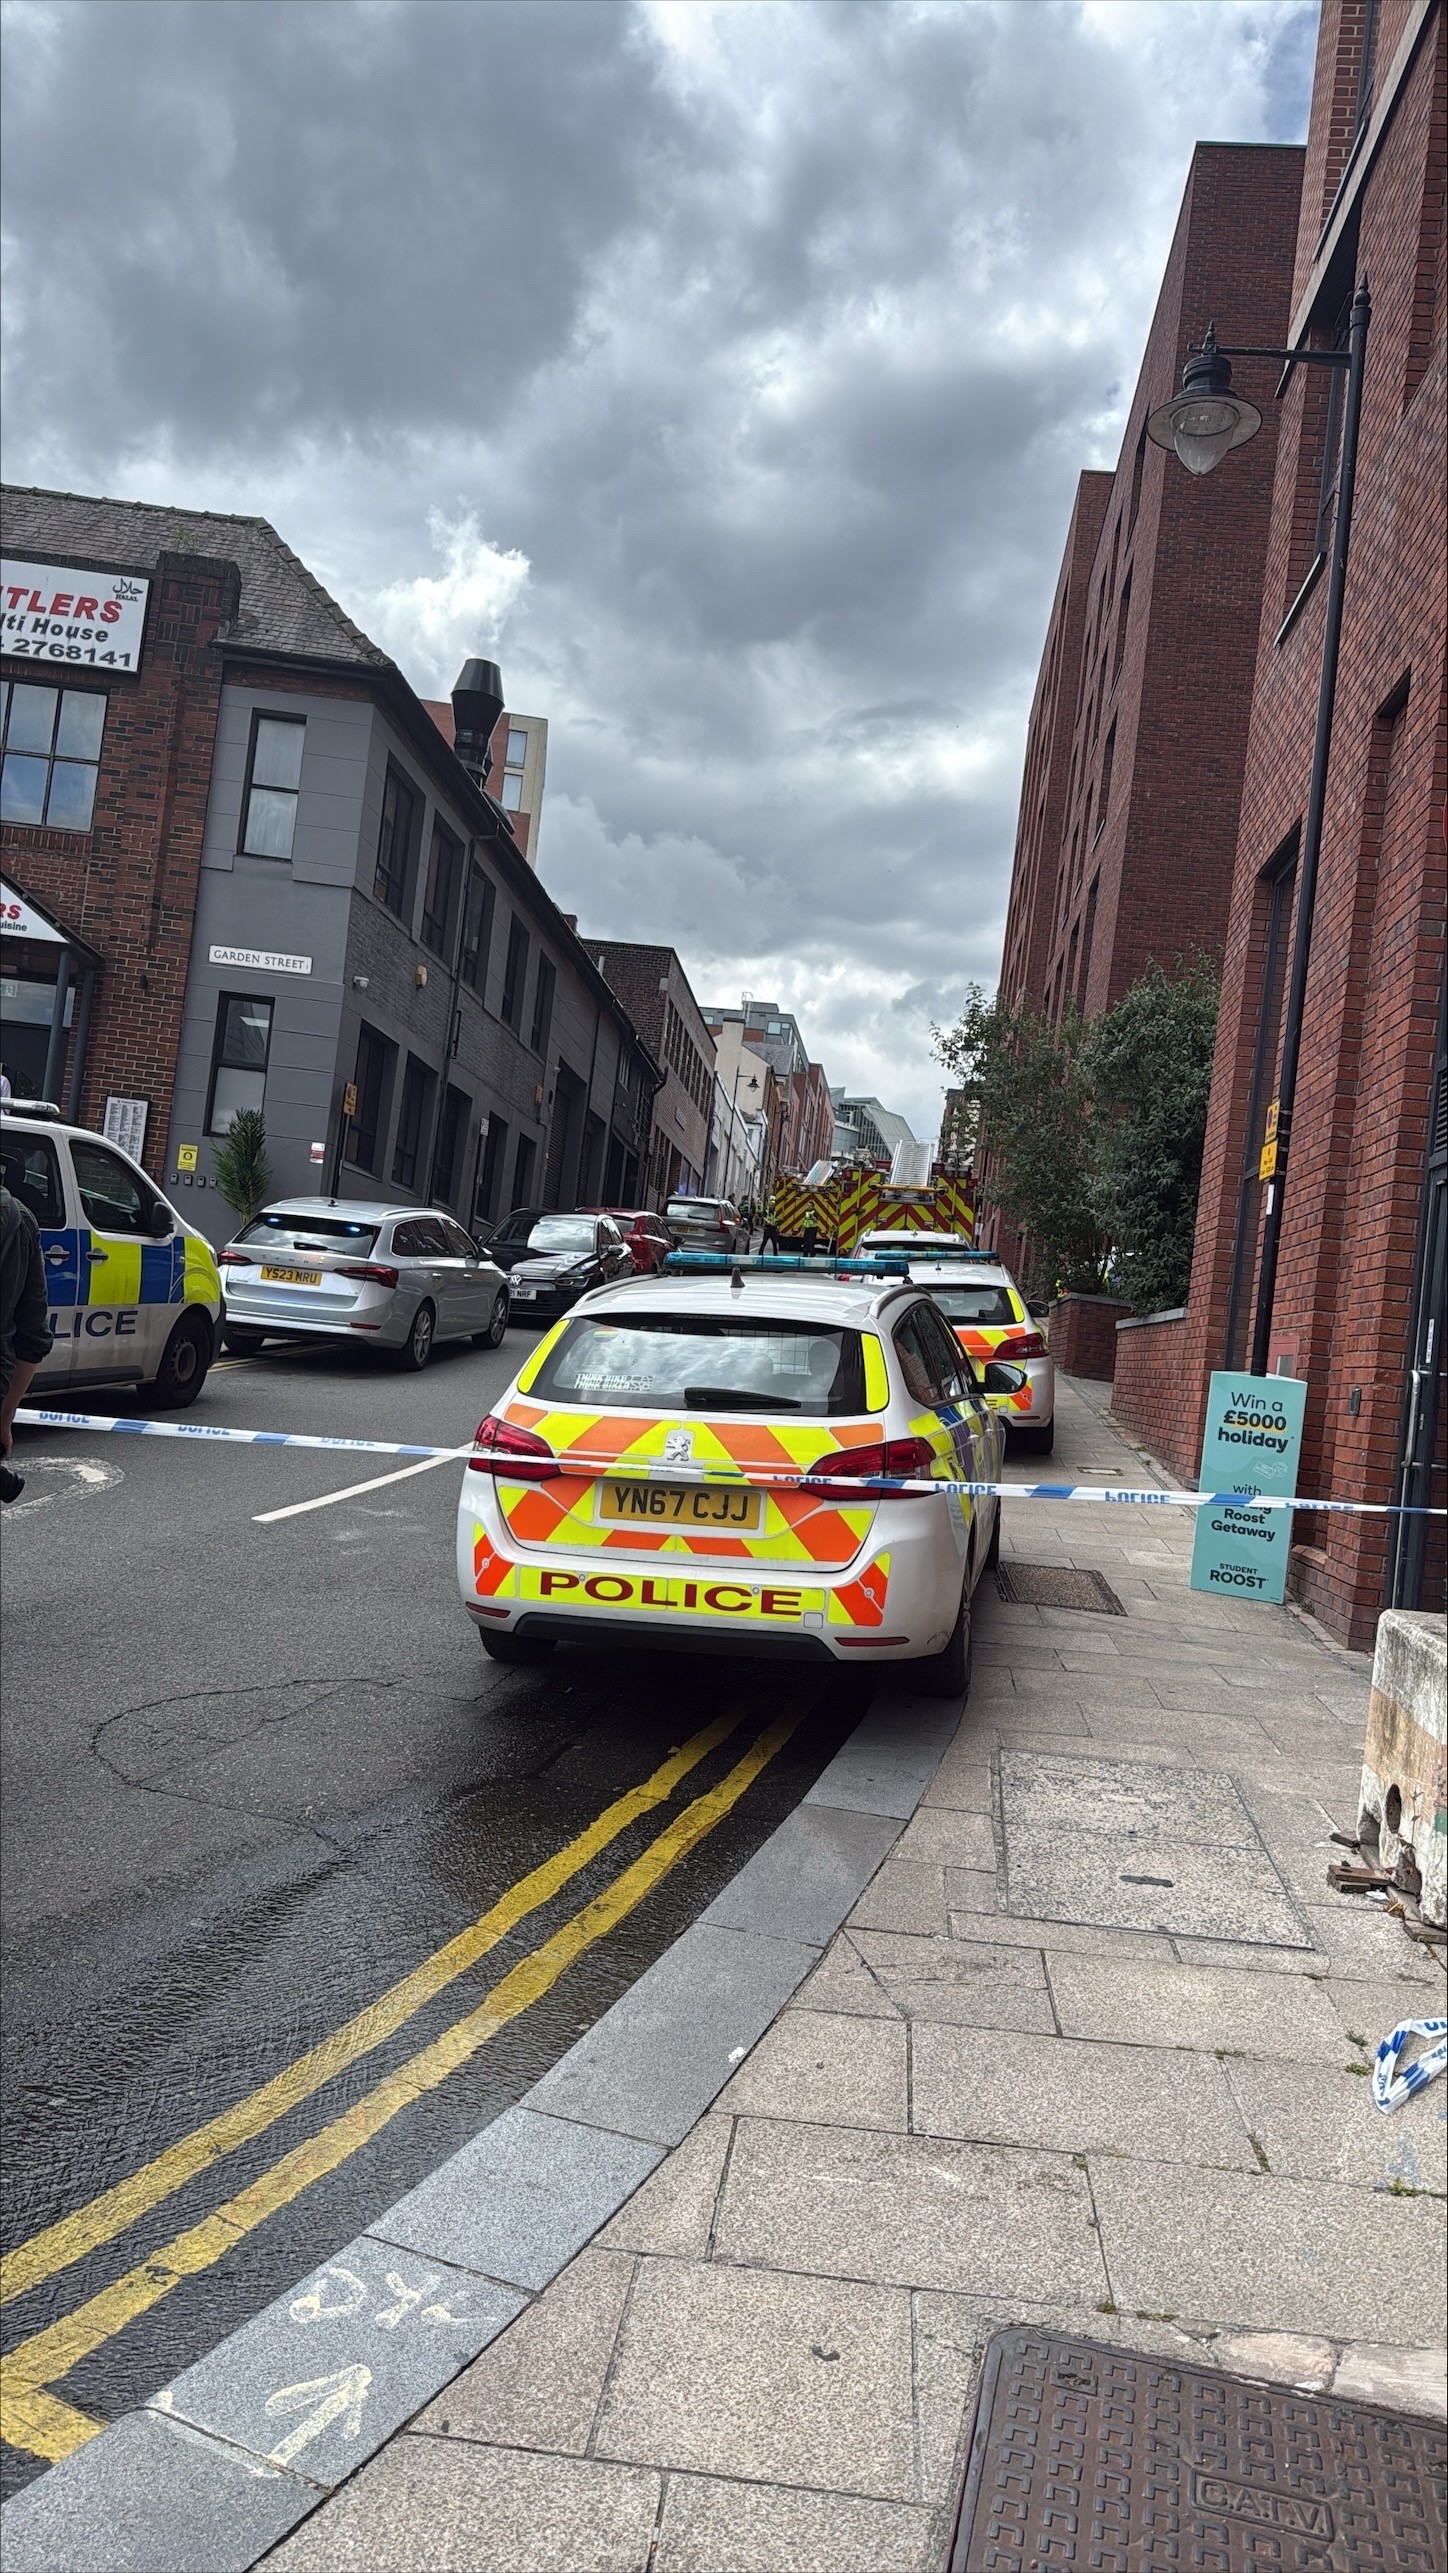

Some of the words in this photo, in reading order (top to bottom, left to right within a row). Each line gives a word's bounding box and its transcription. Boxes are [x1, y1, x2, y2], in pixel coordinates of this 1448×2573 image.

[0, 586, 122, 623] TLERS
[115, 594, 138, 602] HALAL
[30, 617, 109, 642] House
[12, 638, 131, 667] 2768141
[213, 949, 260, 963] GARDEN
[264, 956, 305, 969] STREET
[266, 1266, 293, 1281] YS23
[516, 1289, 532, 1298] NRF
[49, 1310, 138, 1339] LICE
[574, 1380, 602, 1390] THINK
[1231, 1392, 1267, 1410] Win
[1271, 1401, 1283, 1412] a
[1223, 1409, 1287, 1431] £5000
[1218, 1427, 1289, 1454] holiday
[1233, 1484, 1262, 1496] with
[615, 1487, 686, 1517] YN67
[692, 1493, 749, 1521] CJJ
[1224, 1508, 1266, 1524] Roost
[1211, 1520, 1276, 1542] Getaway
[1210, 1569, 1267, 1589] ROOST
[1219, 1563, 1259, 1575] STUDENT
[540, 1571, 802, 1616] POLICE
